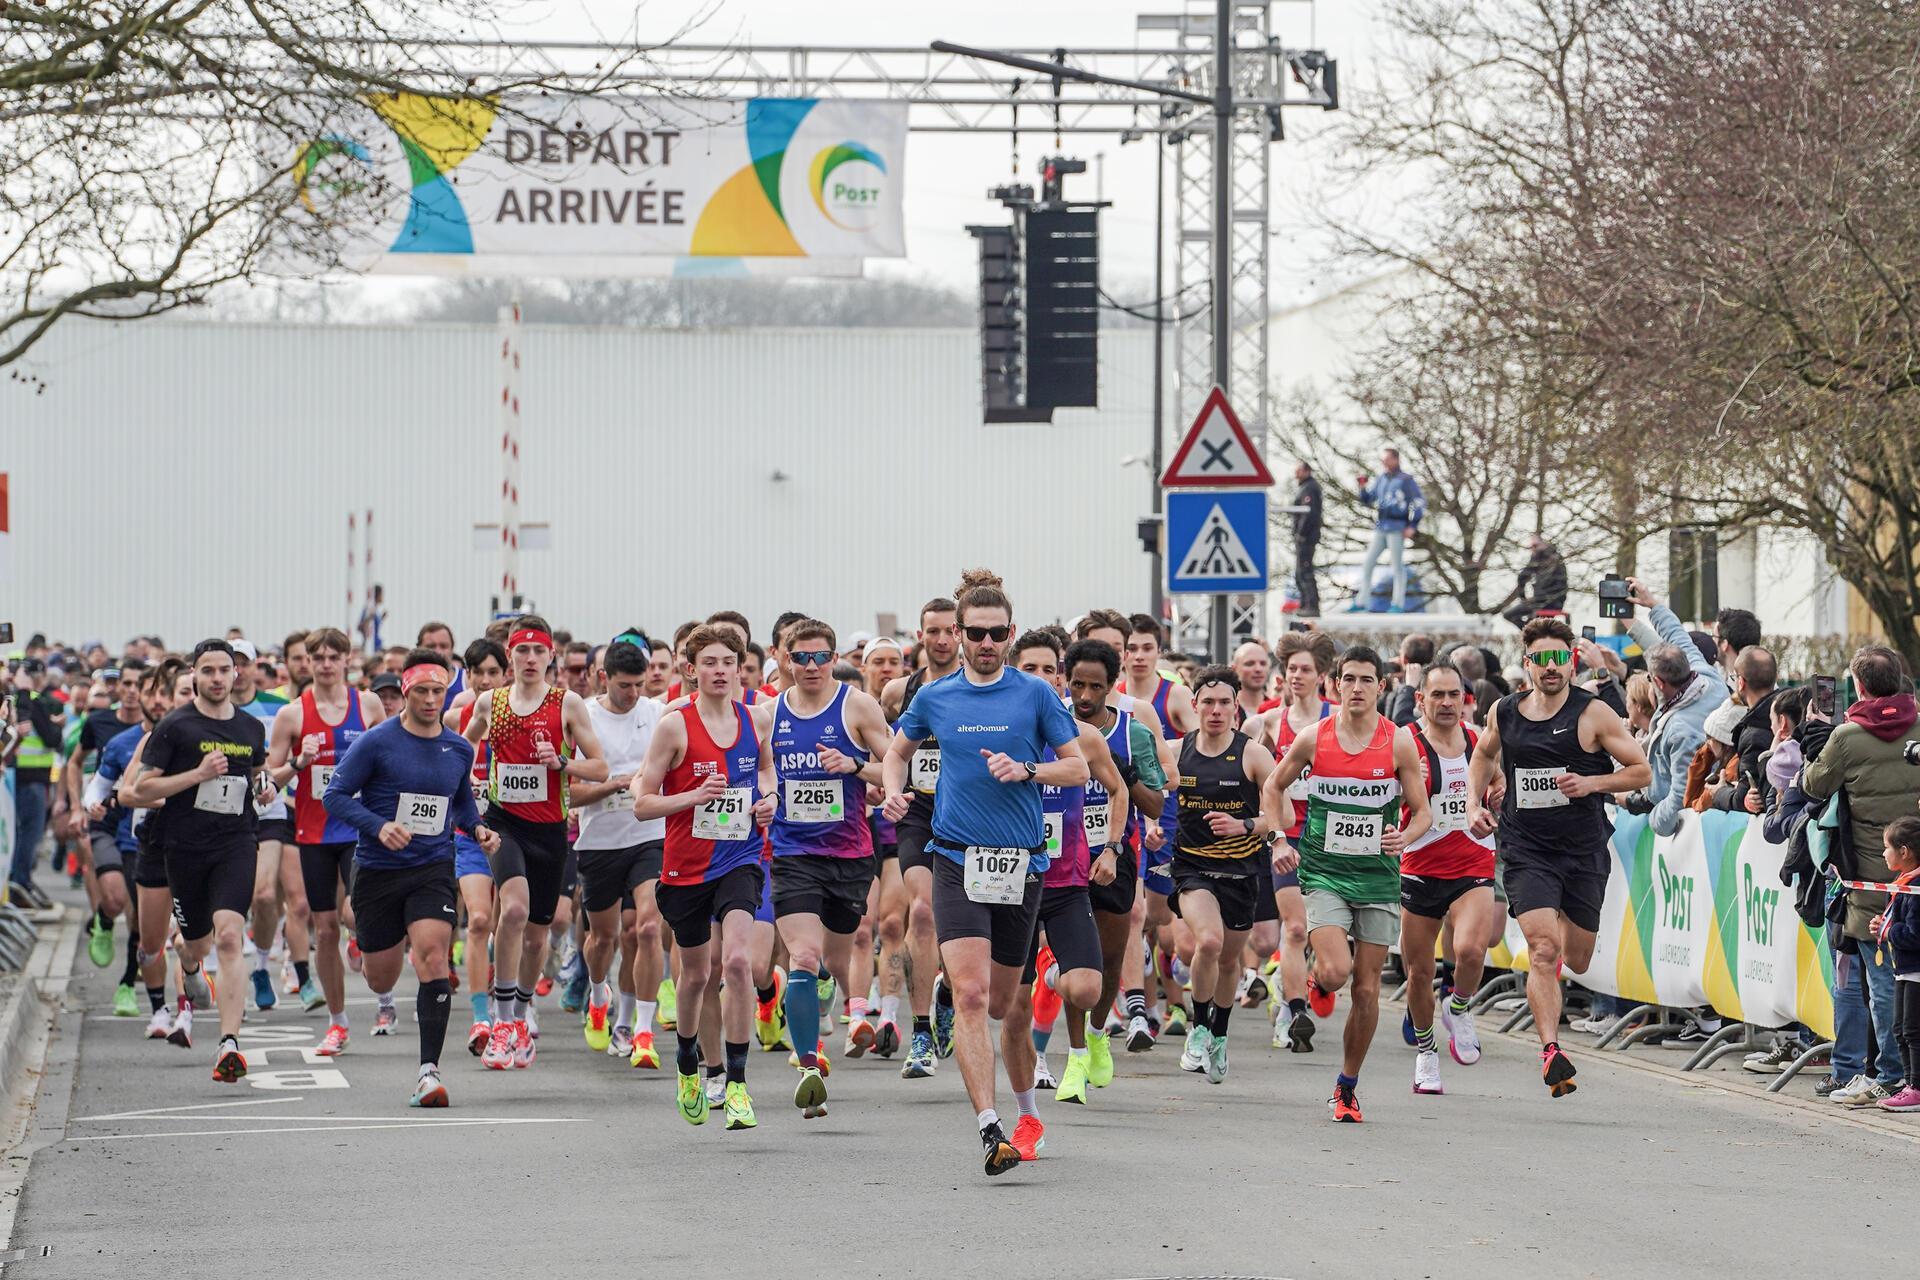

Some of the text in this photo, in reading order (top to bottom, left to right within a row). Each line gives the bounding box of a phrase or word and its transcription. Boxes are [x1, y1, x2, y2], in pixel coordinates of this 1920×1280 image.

[496, 181, 685, 225] ARRIVÉE
[222, 784, 229, 797] 1
[502, 775, 539, 790] 4068
[1317, 782, 1390, 797] HUNGARY
[1521, 776, 1558, 792] 3088
[793, 789, 835, 805] 2265
[1187, 800, 1246, 810] emile weber
[411, 802, 438, 818] 296
[704, 797, 743, 814] 2751
[1341, 814, 1369, 822] POSTLAF
[1334, 822, 1374, 838] 2843
[975, 855, 1020, 874] 1067
